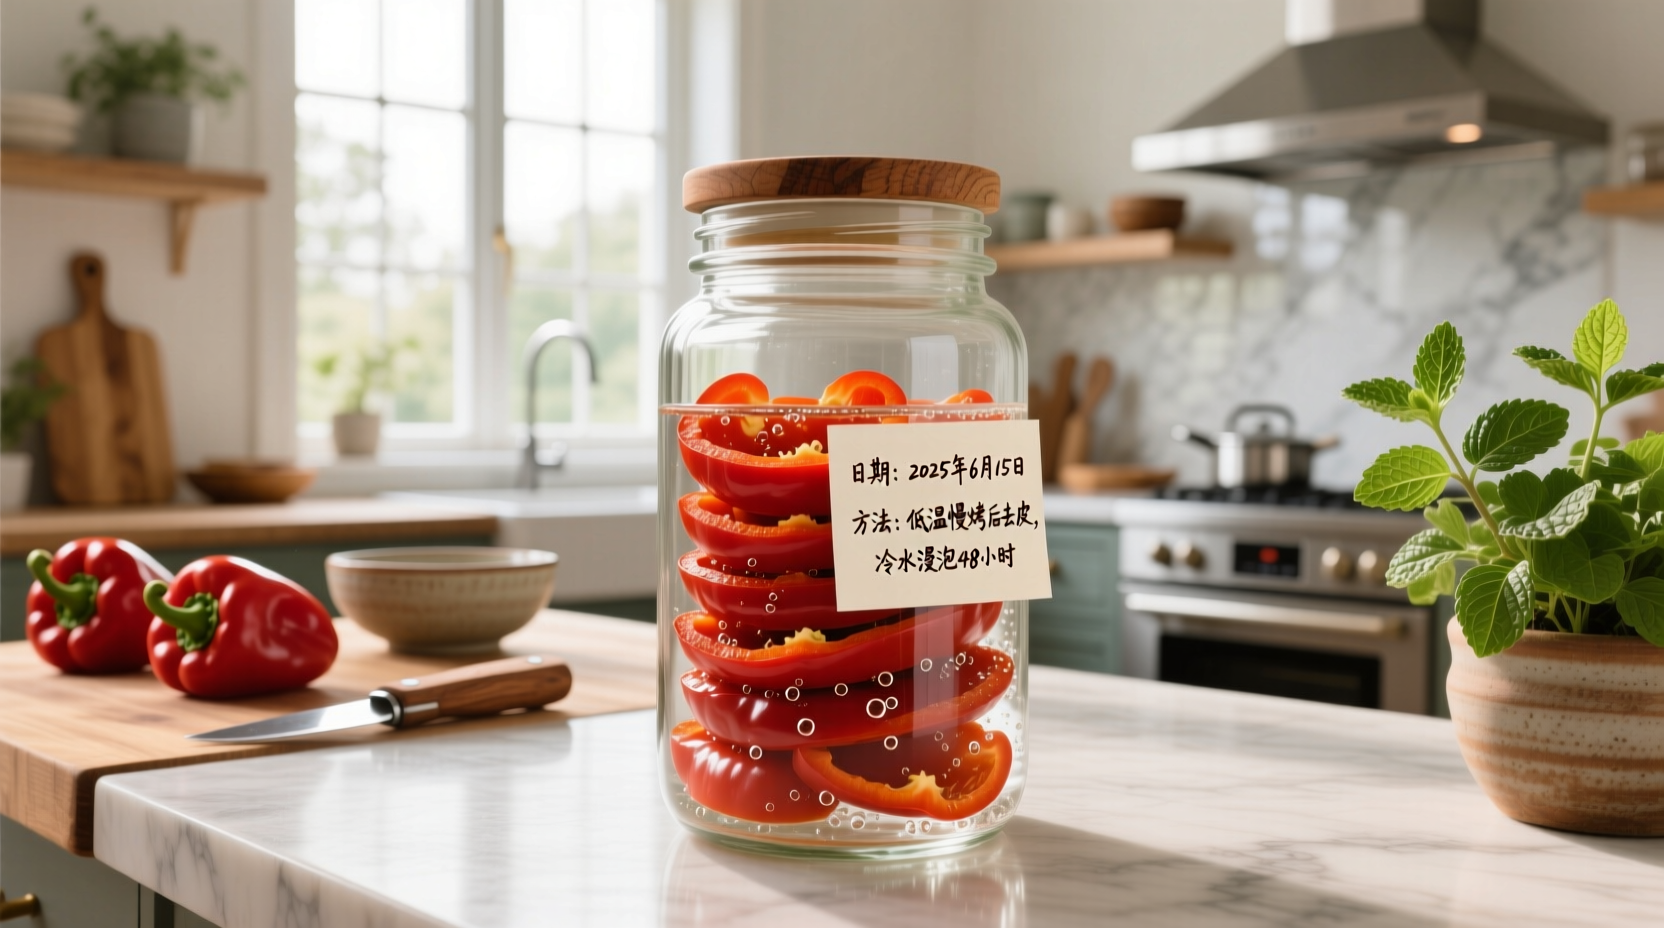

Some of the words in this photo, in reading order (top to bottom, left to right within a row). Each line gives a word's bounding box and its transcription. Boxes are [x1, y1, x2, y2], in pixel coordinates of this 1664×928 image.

[852, 454, 1024, 486] 日期：2025年6月15日
[852, 501, 1039, 535] 方法：低温慢烤后去皮，
